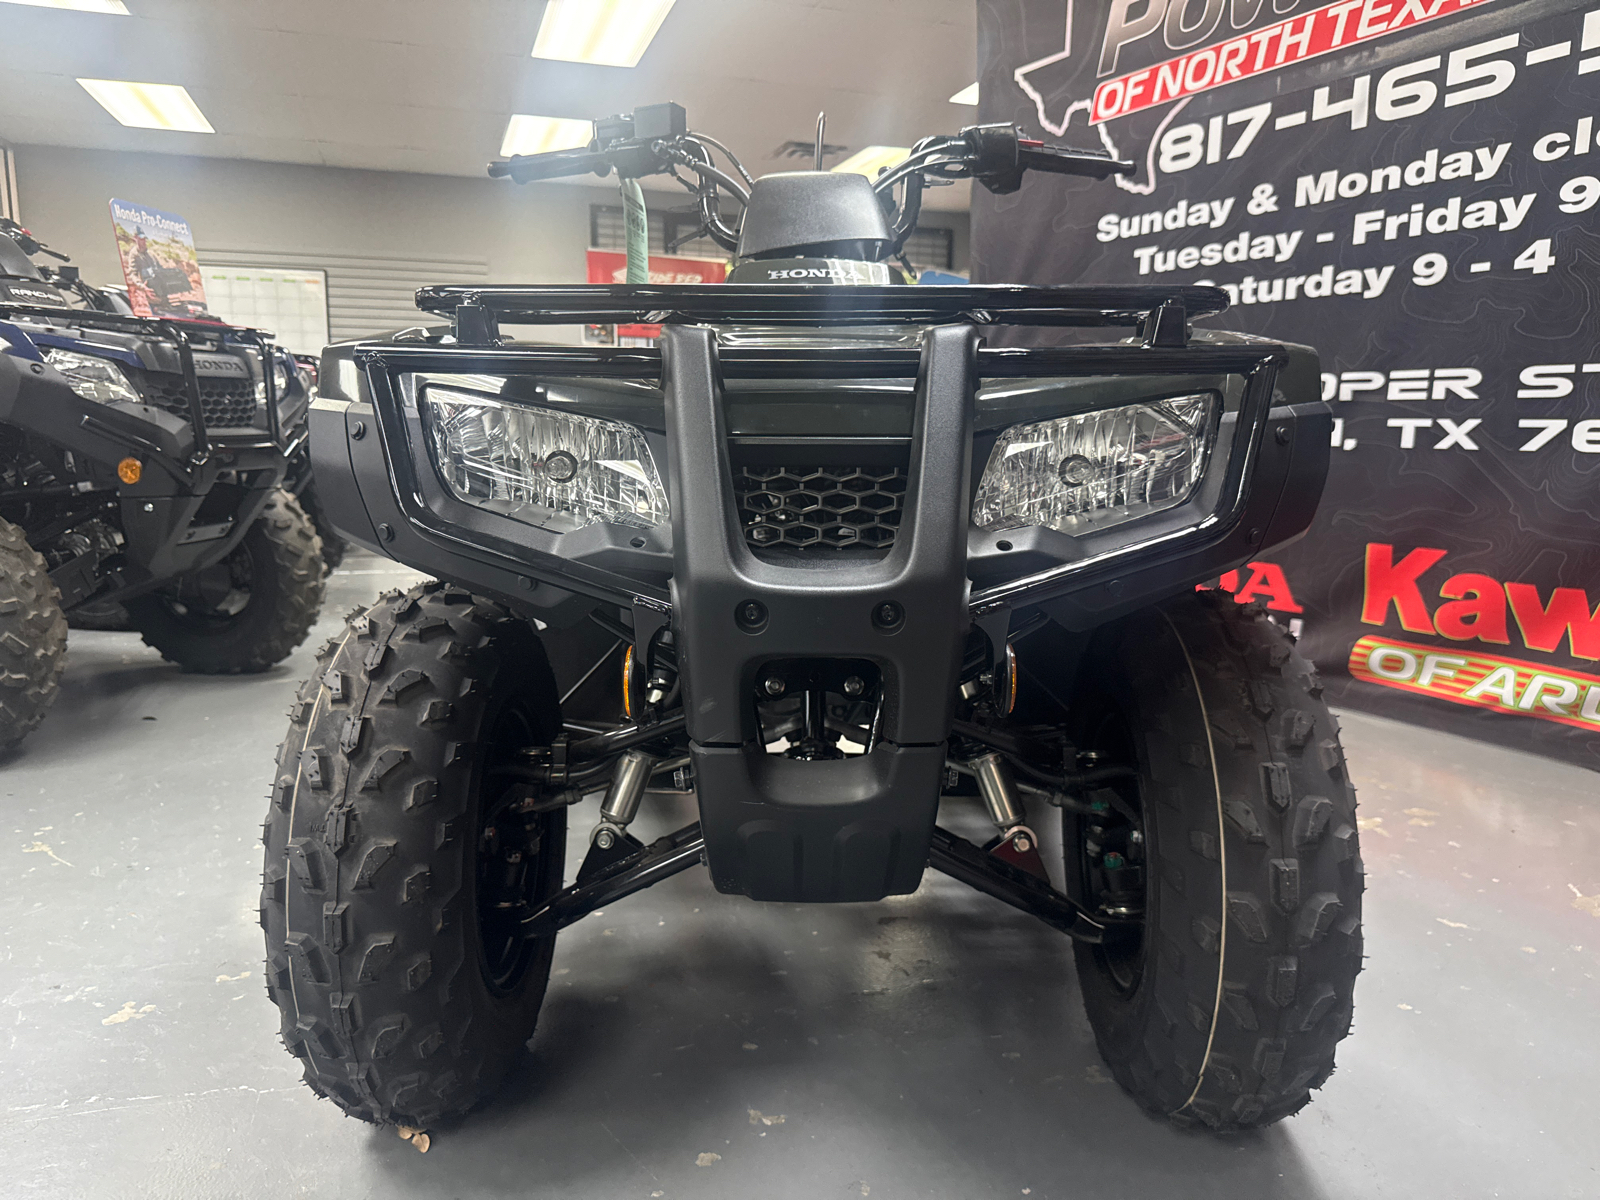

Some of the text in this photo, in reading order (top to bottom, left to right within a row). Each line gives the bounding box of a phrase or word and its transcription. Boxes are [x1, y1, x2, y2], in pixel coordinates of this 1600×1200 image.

[1096, 70, 1151, 119] OF
[1152, 13, 1317, 103] NORTH
[1097, 116, 1600, 242] Sunday & Monday cl
[114, 204, 142, 224] Honda
[142, 210, 189, 235] Pro-Connect
[1133, 227, 1304, 275] Tuesday
[1353, 193, 1535, 246] Friday
[1558, 175, 1600, 214] 9
[768, 269, 867, 281] HONDA
[1193, 264, 1396, 306] aturday
[1412, 252, 1448, 287] 9
[1514, 238, 1556, 275] 4
[1387, 418, 1483, 451] TX
[1368, 646, 1468, 687] OF
